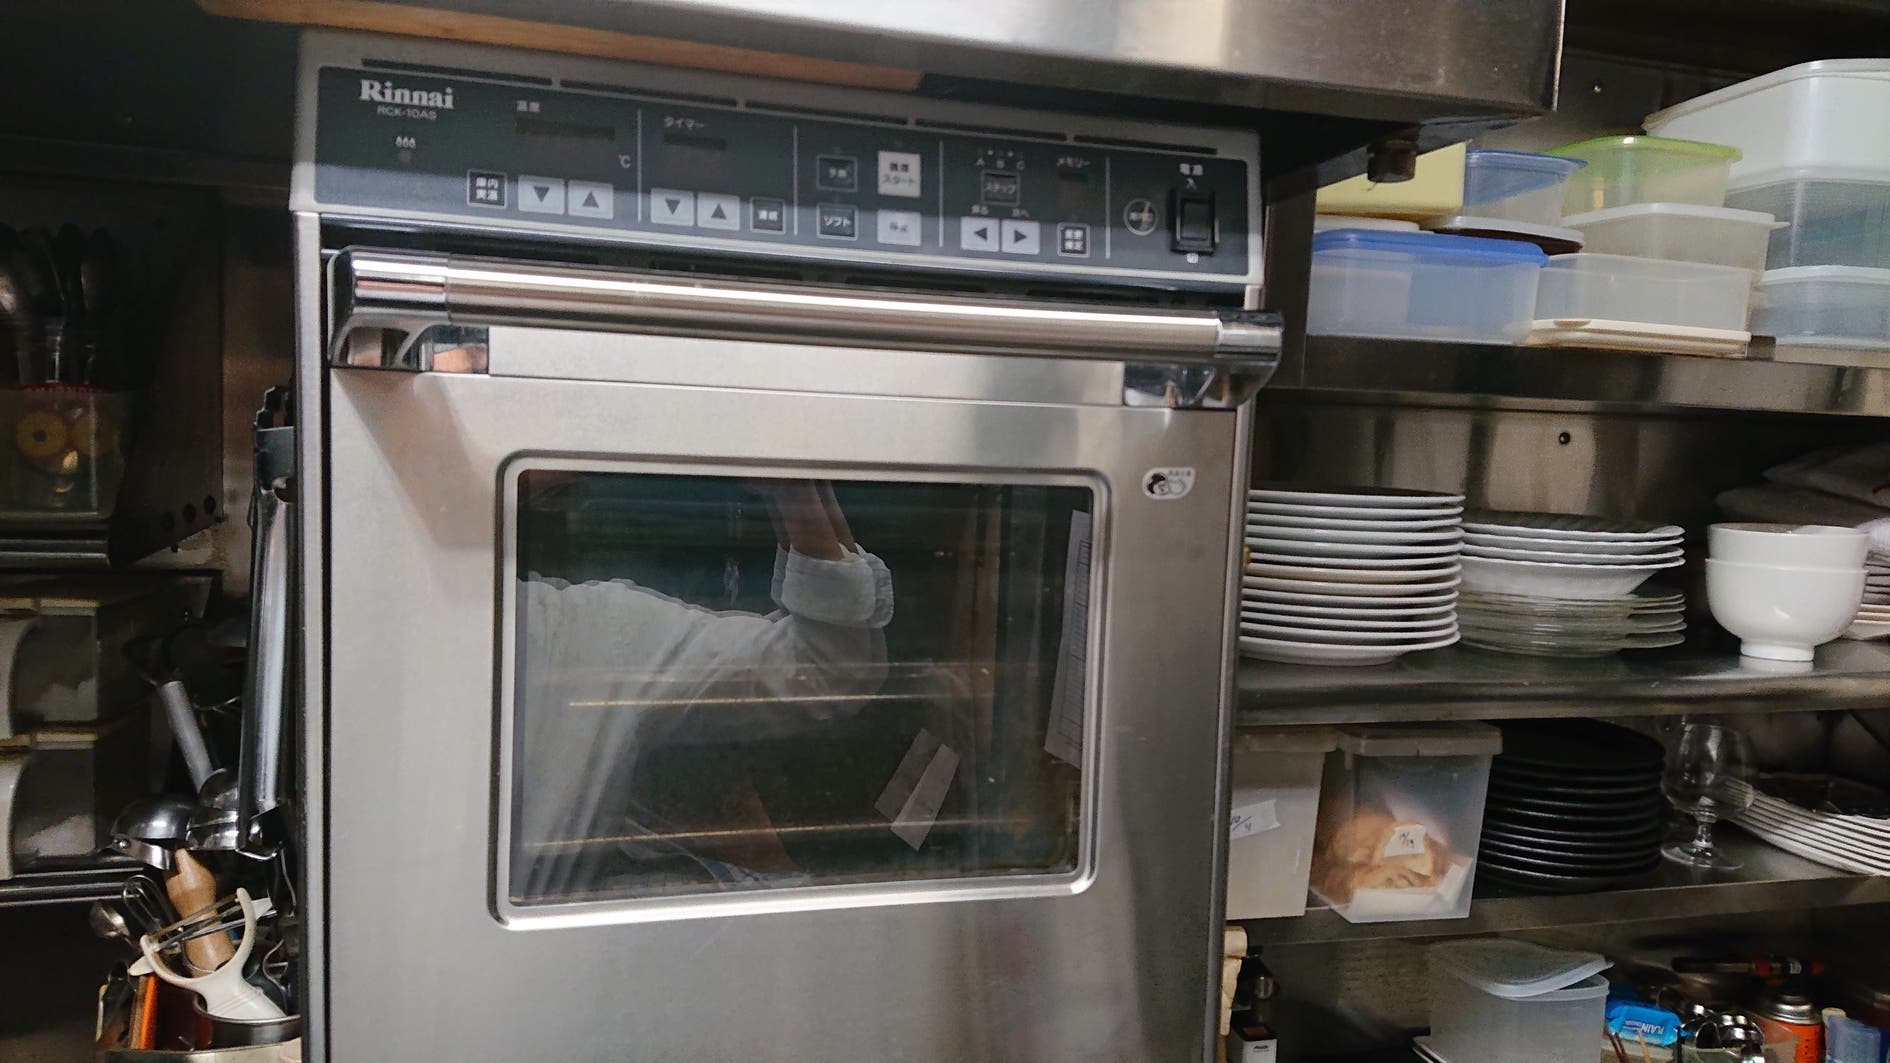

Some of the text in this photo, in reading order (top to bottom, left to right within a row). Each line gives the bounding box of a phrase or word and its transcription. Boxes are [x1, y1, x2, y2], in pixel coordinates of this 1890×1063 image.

[359, 79, 455, 109] Rinnai
[663, 116, 705, 130] タイマー
[1056, 157, 1091, 169] メモリー
[882, 175, 915, 186] スタート
[823, 215, 852, 228] ソフト
[1640, 1022, 1665, 1035] PLAIN
